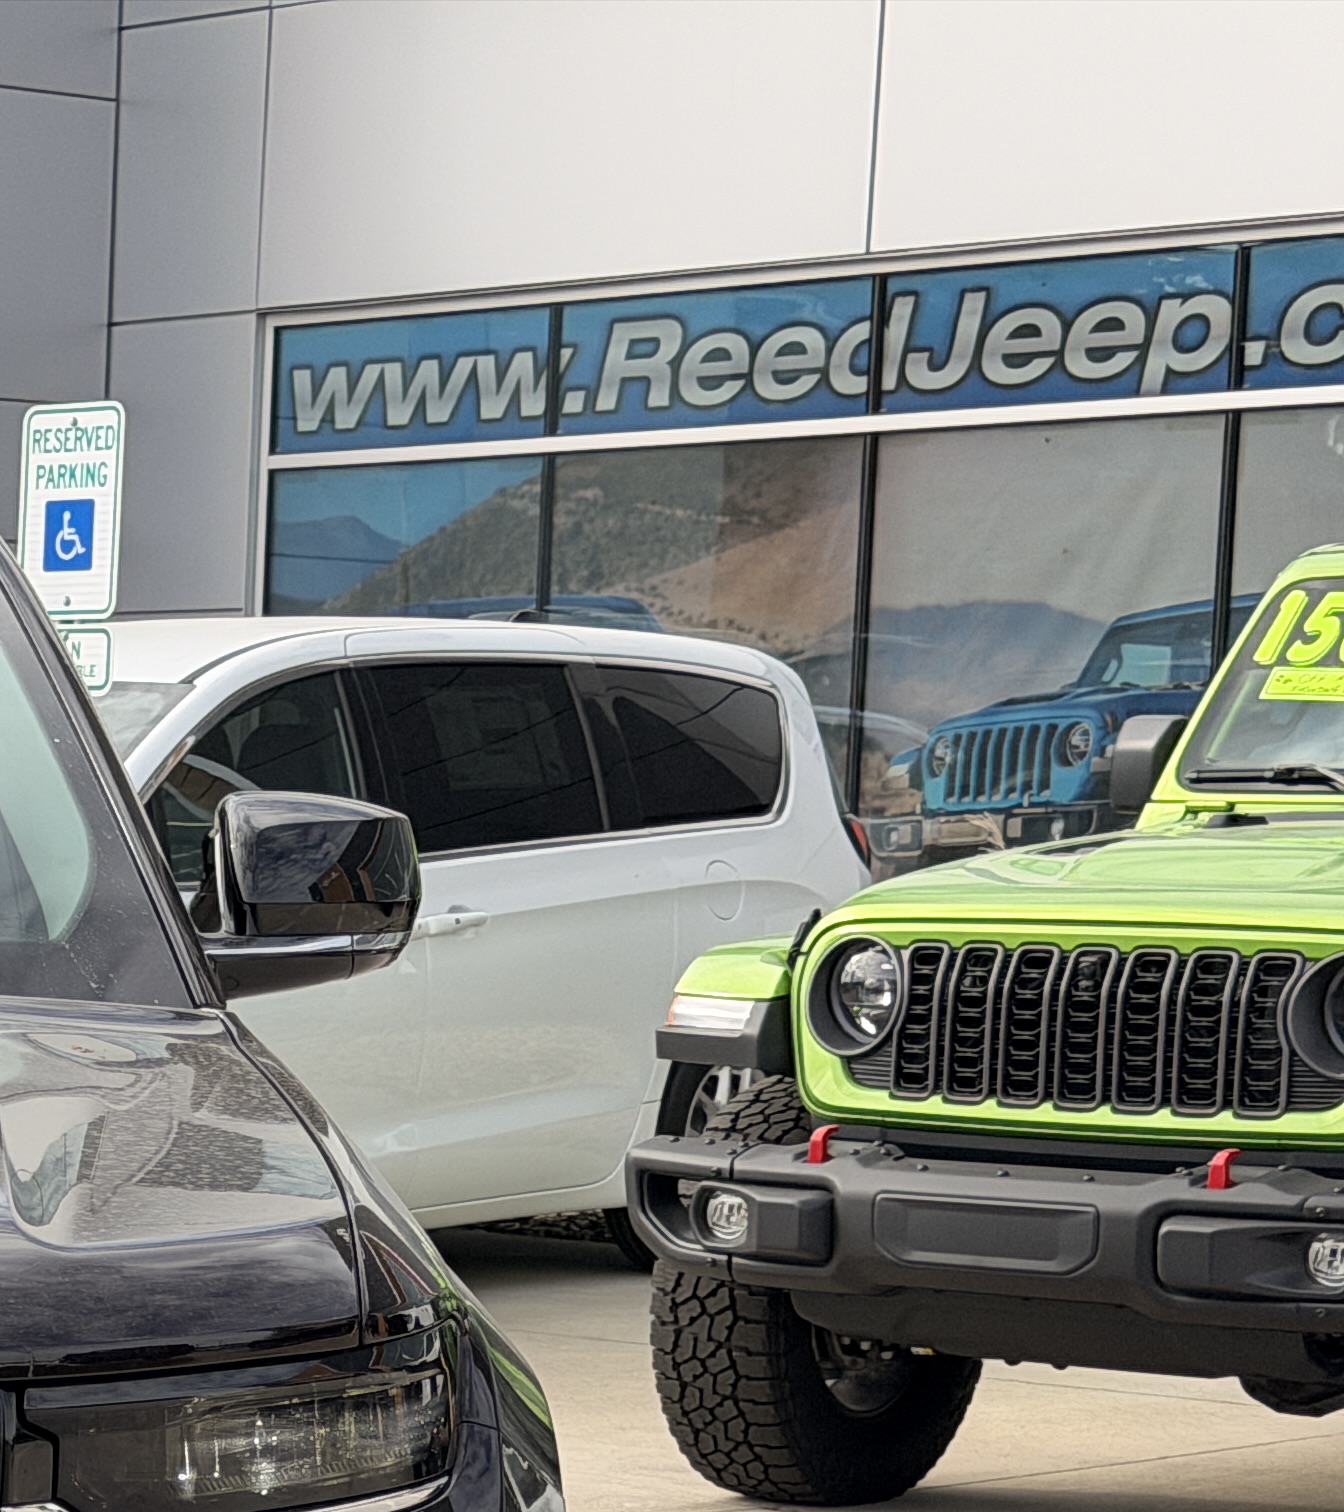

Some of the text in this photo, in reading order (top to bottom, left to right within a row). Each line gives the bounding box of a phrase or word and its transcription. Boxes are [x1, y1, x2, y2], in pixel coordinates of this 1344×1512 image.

[32, 425, 116, 454] RESERVED
[35, 461, 109, 490] PARKING
[1253, 589, 1344, 666] 15
